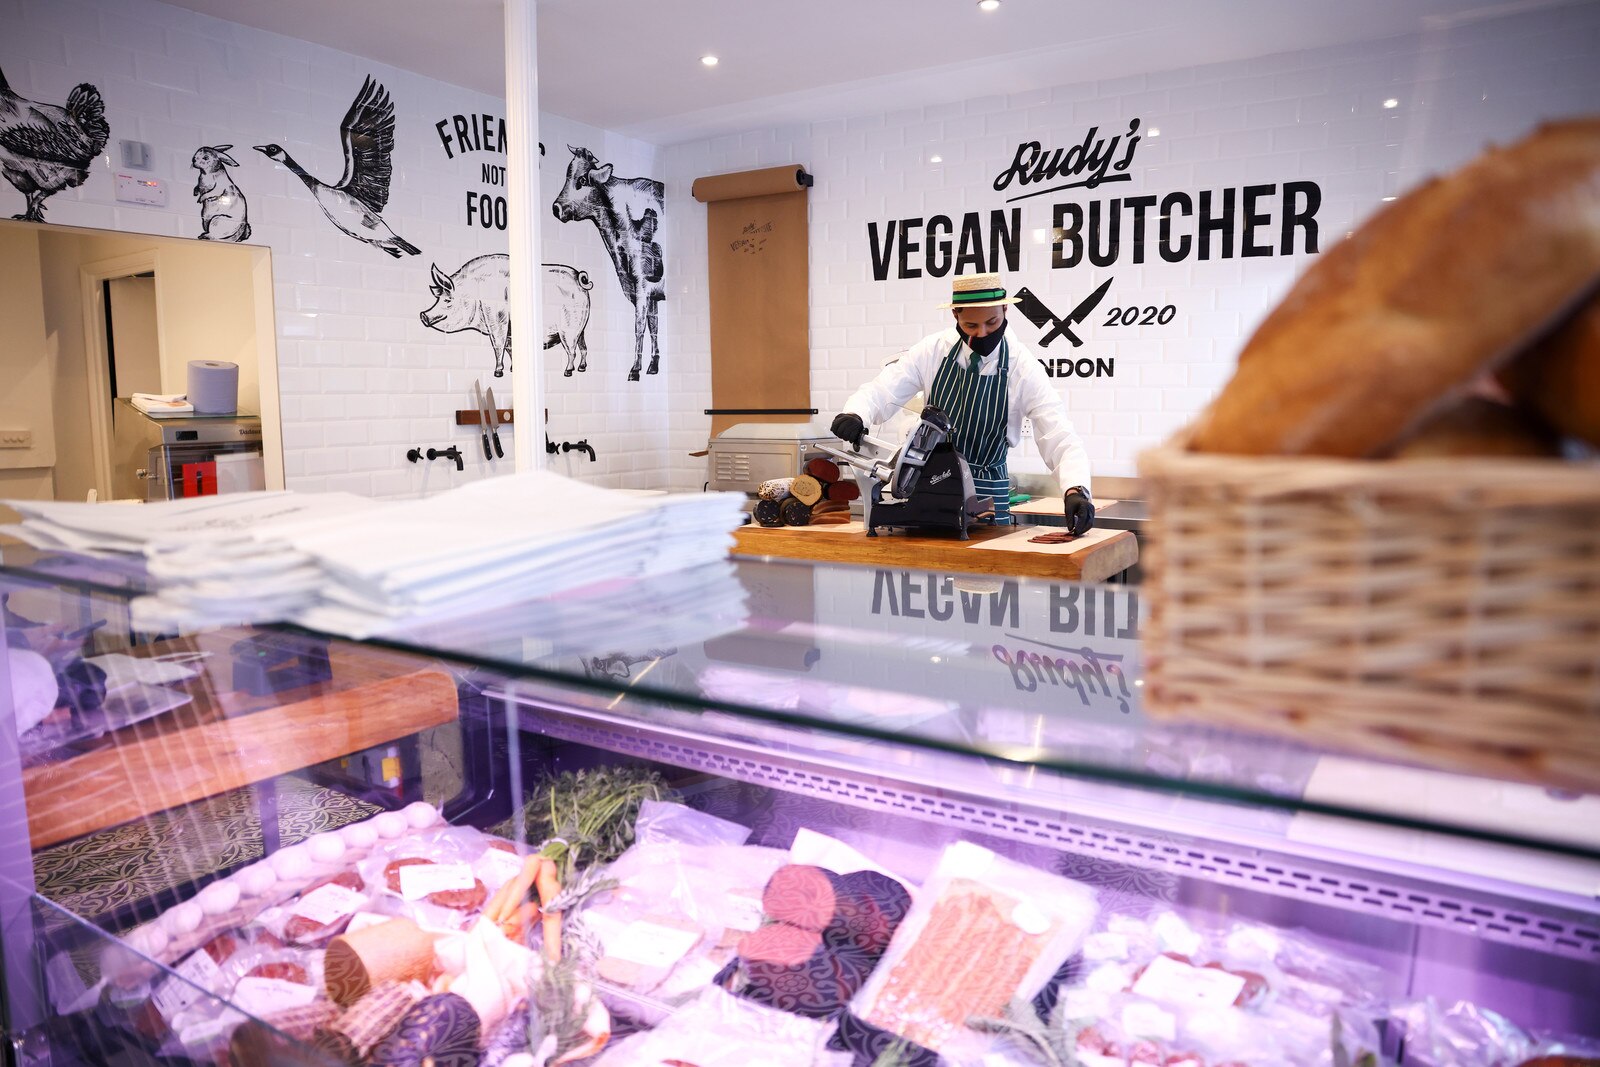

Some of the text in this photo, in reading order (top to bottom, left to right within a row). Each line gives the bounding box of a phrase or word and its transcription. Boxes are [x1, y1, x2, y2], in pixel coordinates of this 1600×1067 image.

[993, 118, 1141, 193] Rudy's
[482, 163, 506, 187] NOT
[467, 191, 507, 231] FOO
[868, 181, 1322, 281] VEGAN BUTCHER
[1102, 305, 1177, 327] 2020
[1037, 357, 1115, 378] NDON
